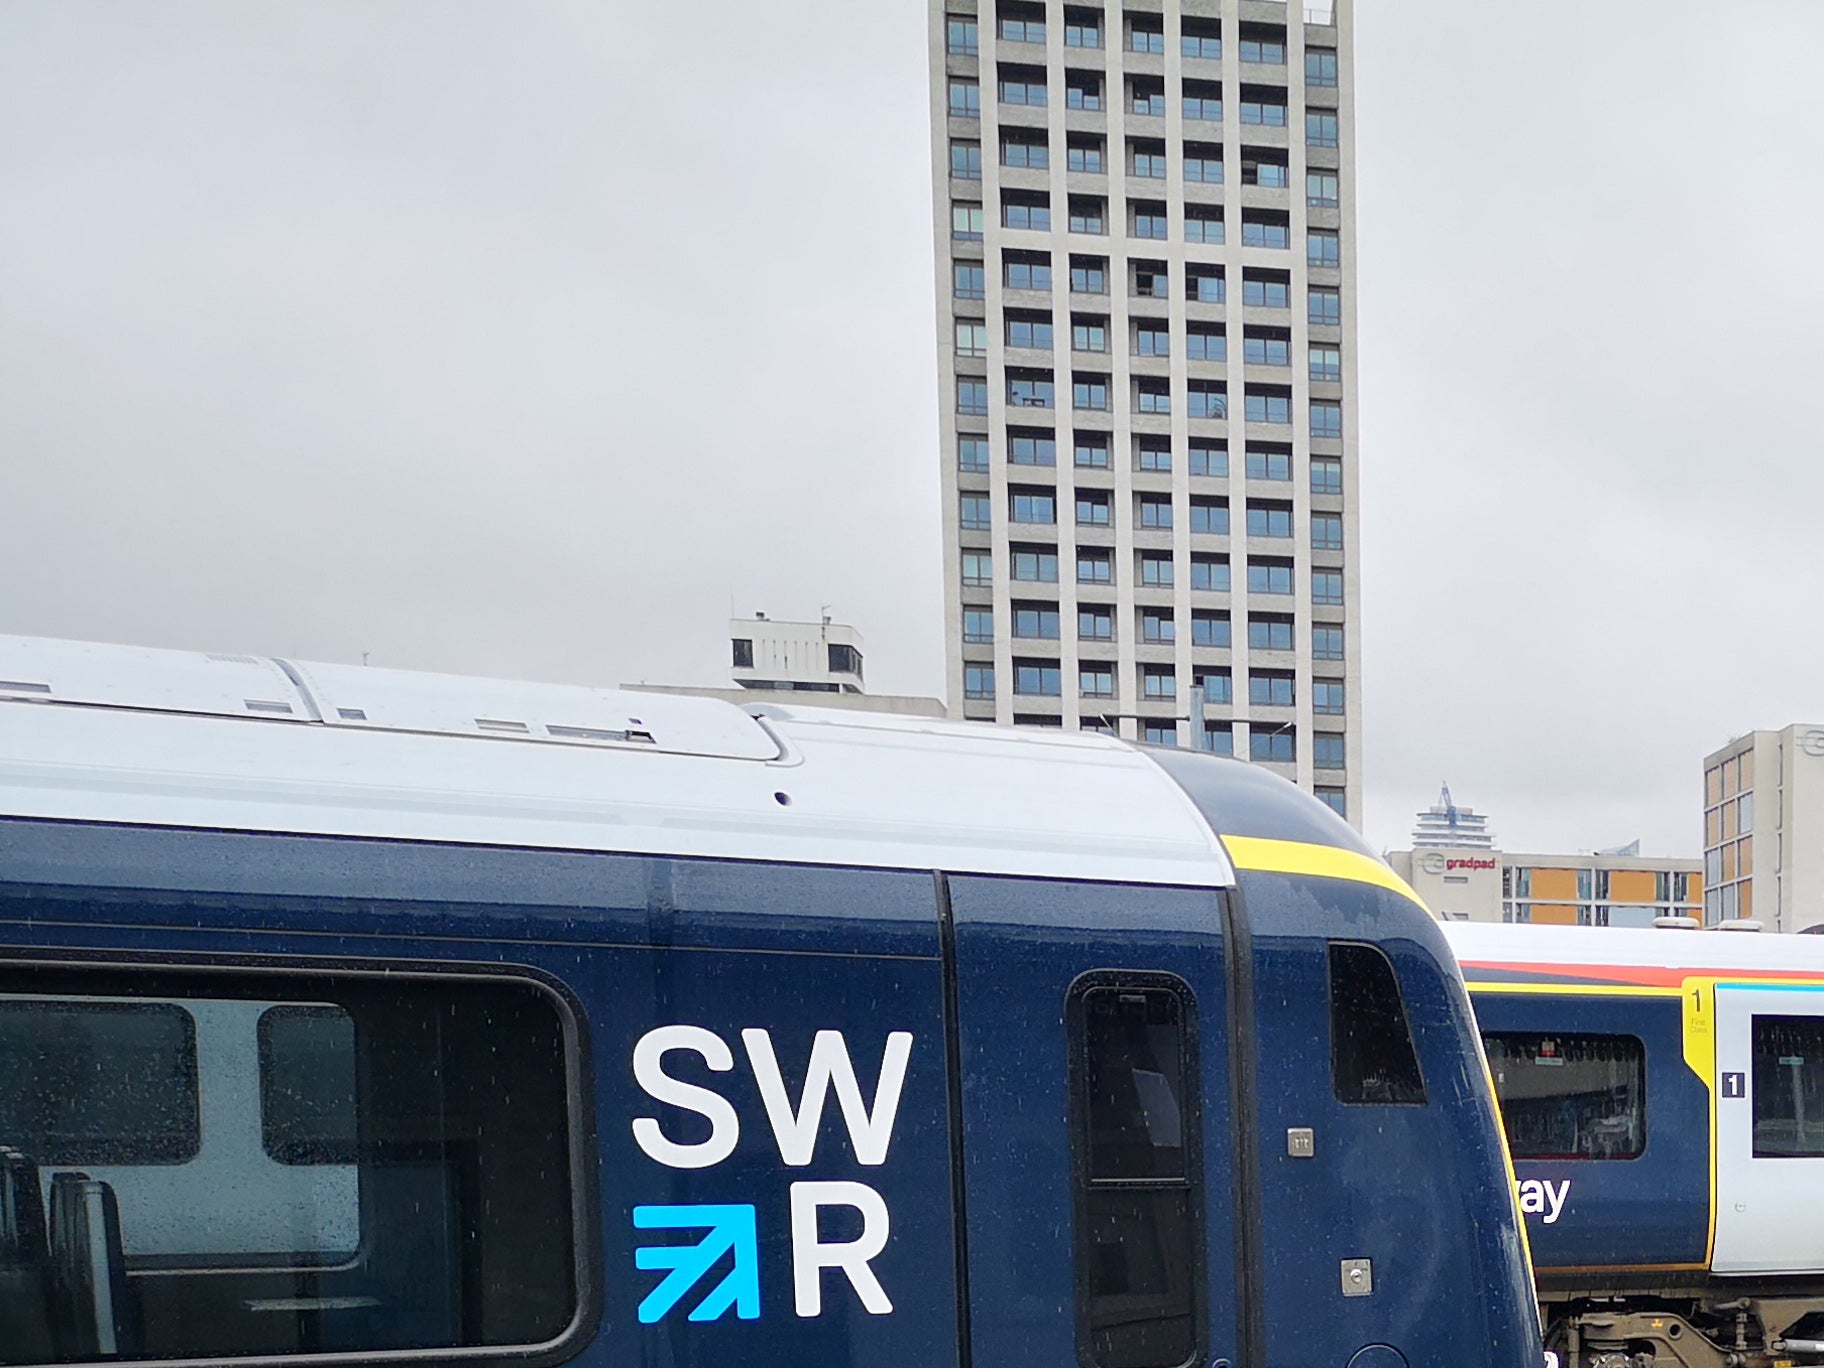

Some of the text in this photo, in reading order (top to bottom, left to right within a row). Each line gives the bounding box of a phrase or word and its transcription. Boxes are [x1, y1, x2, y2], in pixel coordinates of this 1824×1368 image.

[1446, 857, 1496, 870] gradpad
[1691, 989, 1701, 1012] 1
[632, 1024, 914, 1169] SW
[1728, 1074, 1738, 1096] 1
[789, 1180, 894, 1318] R
